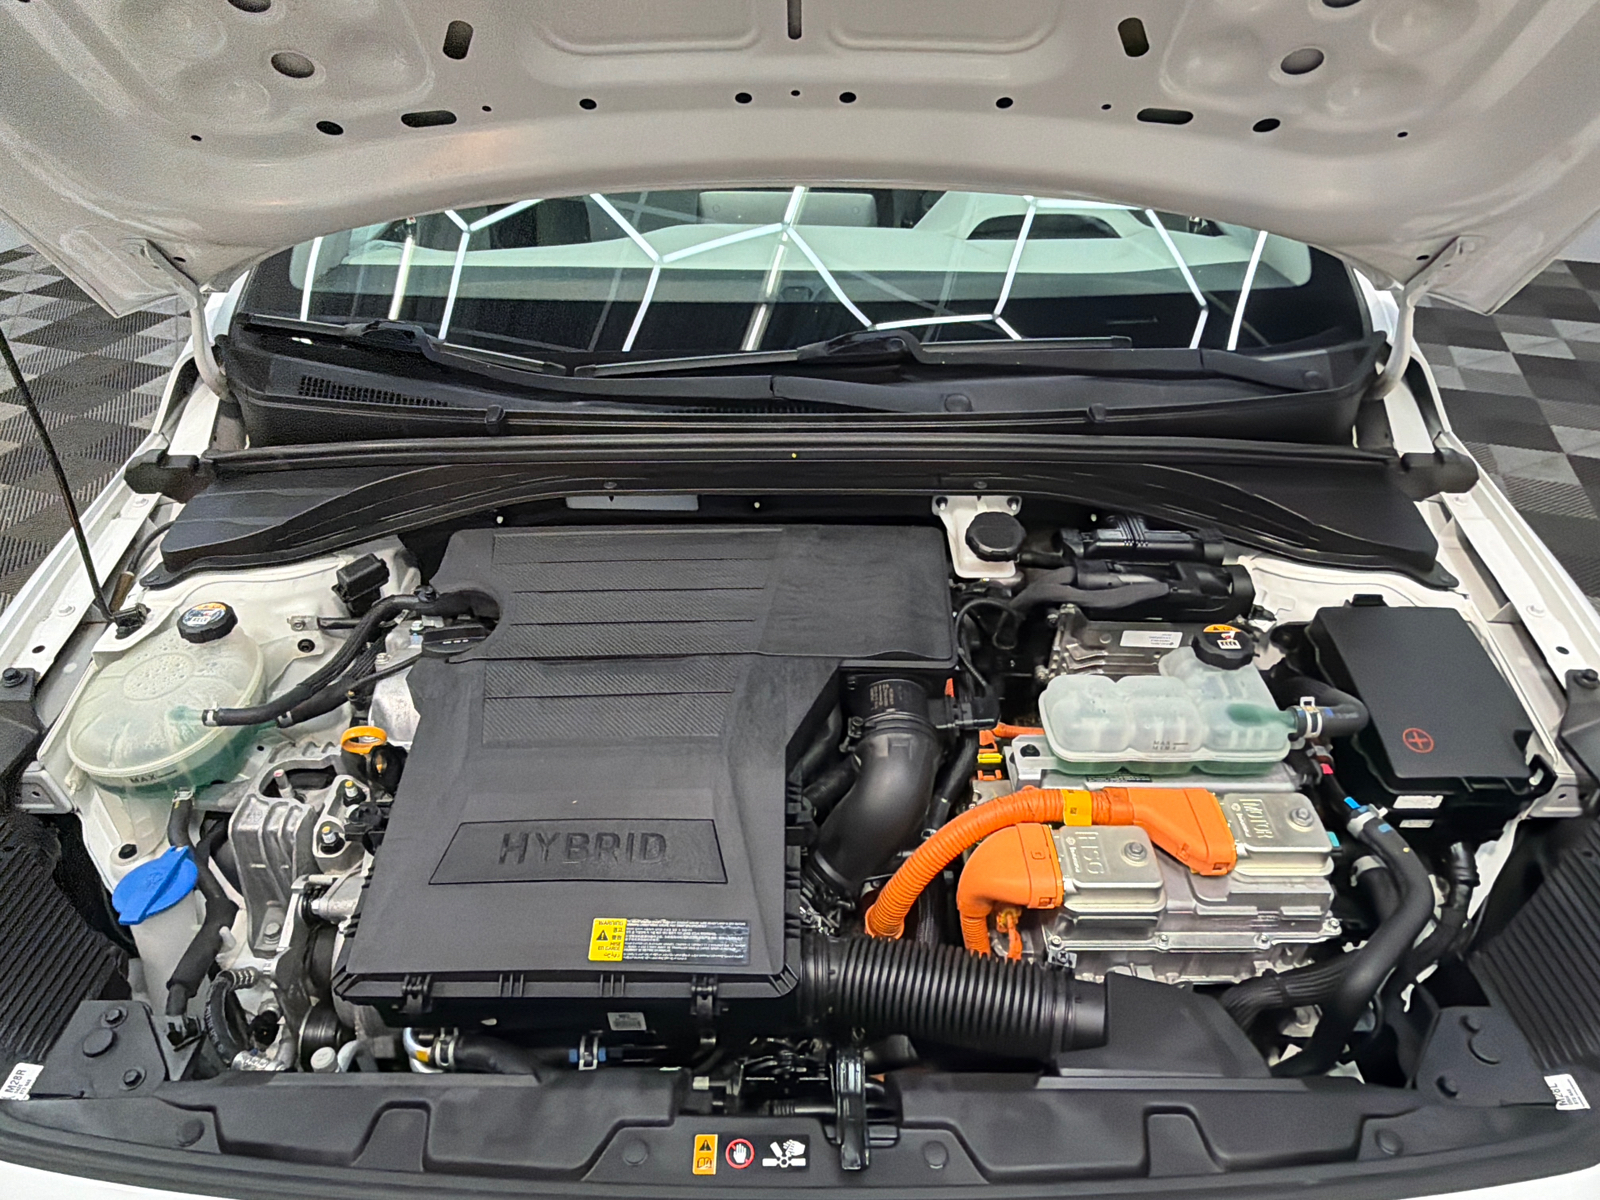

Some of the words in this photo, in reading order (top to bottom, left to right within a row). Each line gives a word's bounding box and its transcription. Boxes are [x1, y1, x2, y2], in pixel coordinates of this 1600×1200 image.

[130, 773, 157, 783] MAX
[1239, 798, 1274, 839] MOTOR
[498, 832, 668, 865] HYBRID
[5, 1070, 27, 1093] M28R
